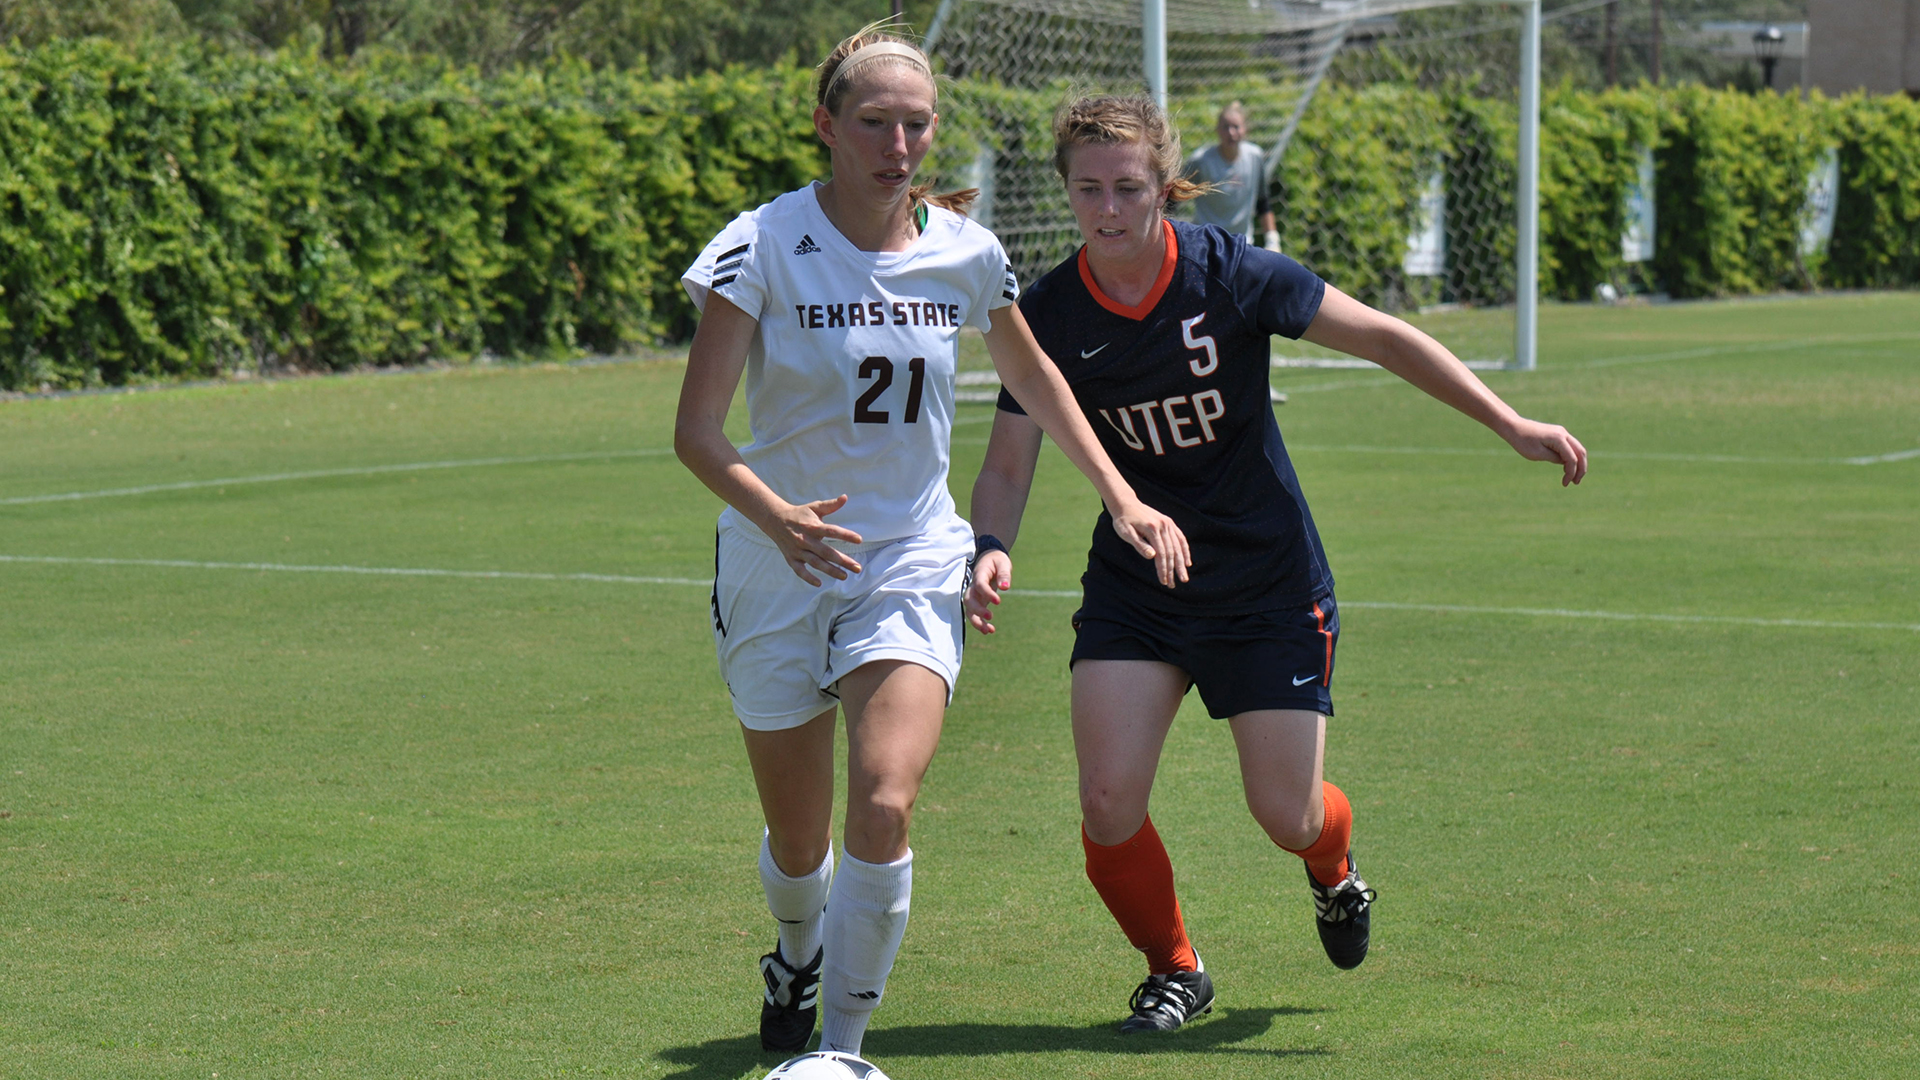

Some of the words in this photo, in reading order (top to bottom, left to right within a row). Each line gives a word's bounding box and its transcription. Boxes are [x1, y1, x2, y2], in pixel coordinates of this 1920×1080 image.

[794, 245, 821, 255] adidas
[796, 302, 885, 328] TEXAS
[893, 302, 959, 327] STATE
[1181, 311, 1218, 377] 5
[854, 356, 925, 423] 21
[1099, 389, 1225, 456] UTEP
